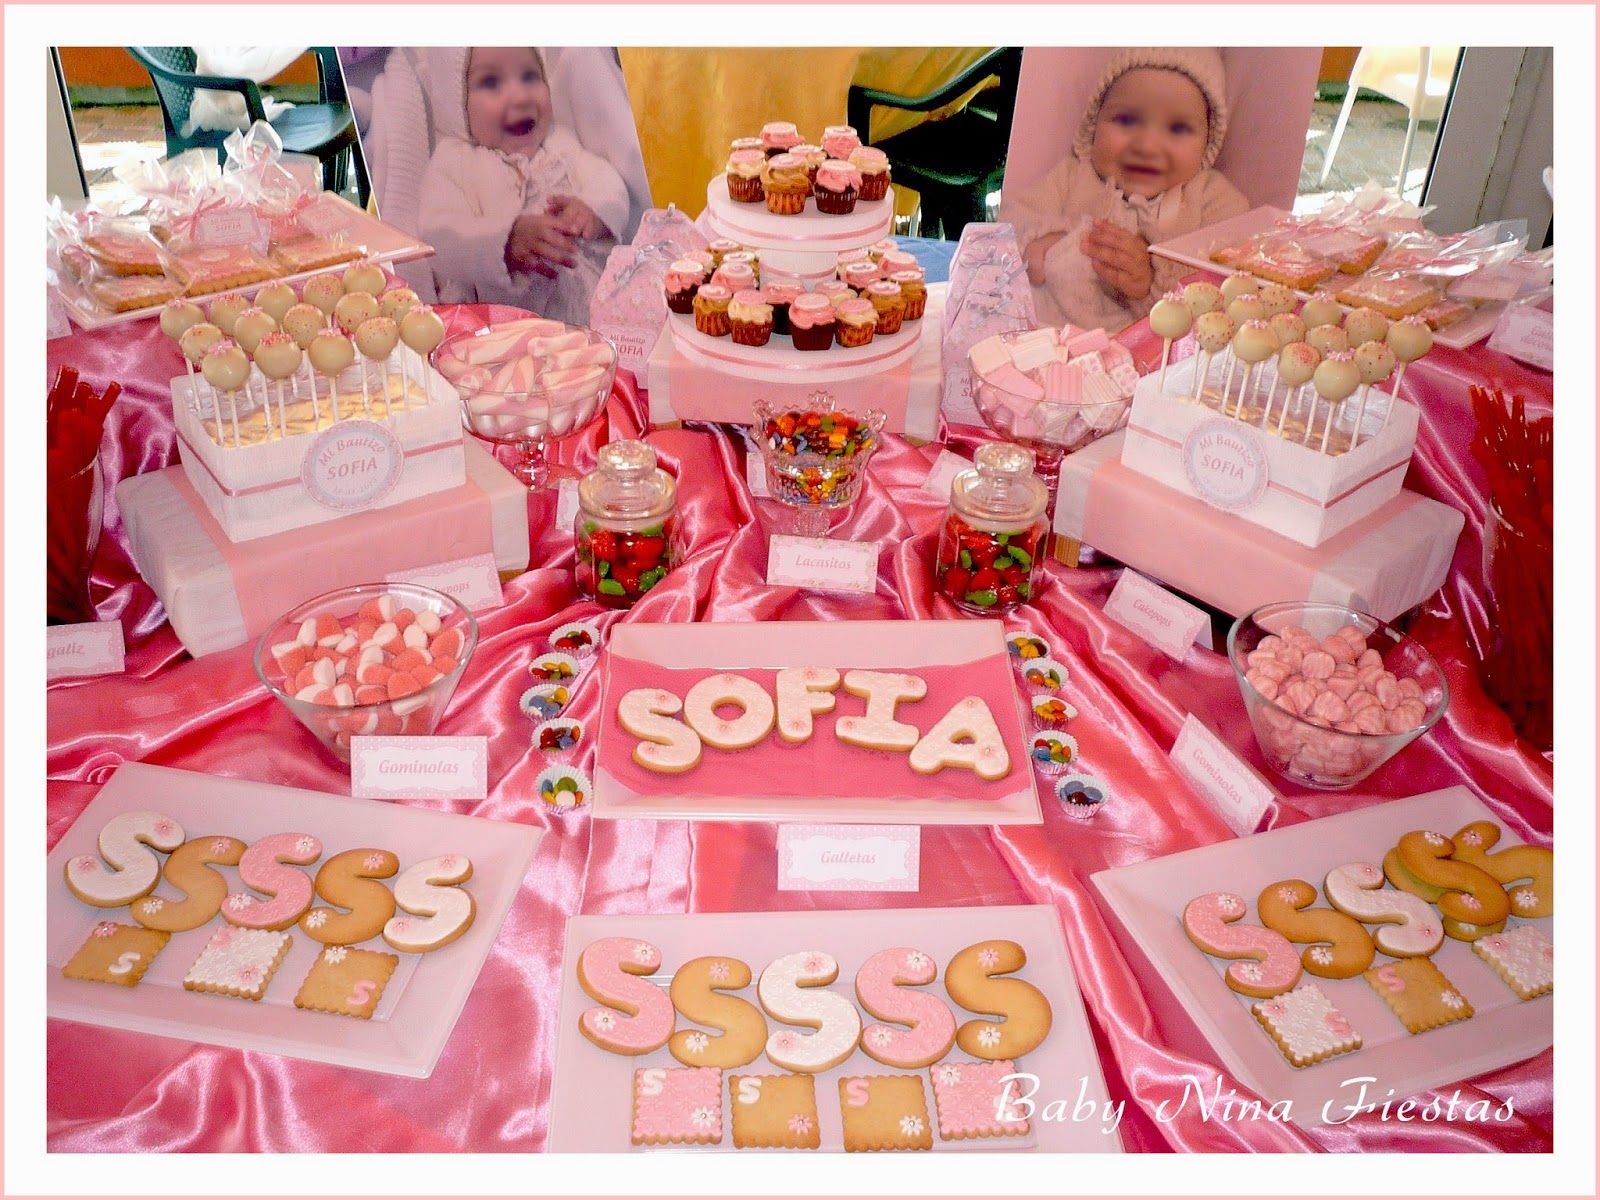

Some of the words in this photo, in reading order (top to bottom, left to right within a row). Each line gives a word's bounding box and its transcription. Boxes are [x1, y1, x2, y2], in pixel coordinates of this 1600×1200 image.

[616, 344, 643, 356] OFIA
[336, 437, 385, 453] Bautizo
[327, 456, 378, 480] SOFIA
[1201, 454, 1244, 480] SOFIA
[795, 554, 852, 569] Lacasitos
[616, 666, 1012, 782] SOFIA
[378, 759, 460, 774] Gominolas
[821, 850, 877, 864] Galletas
